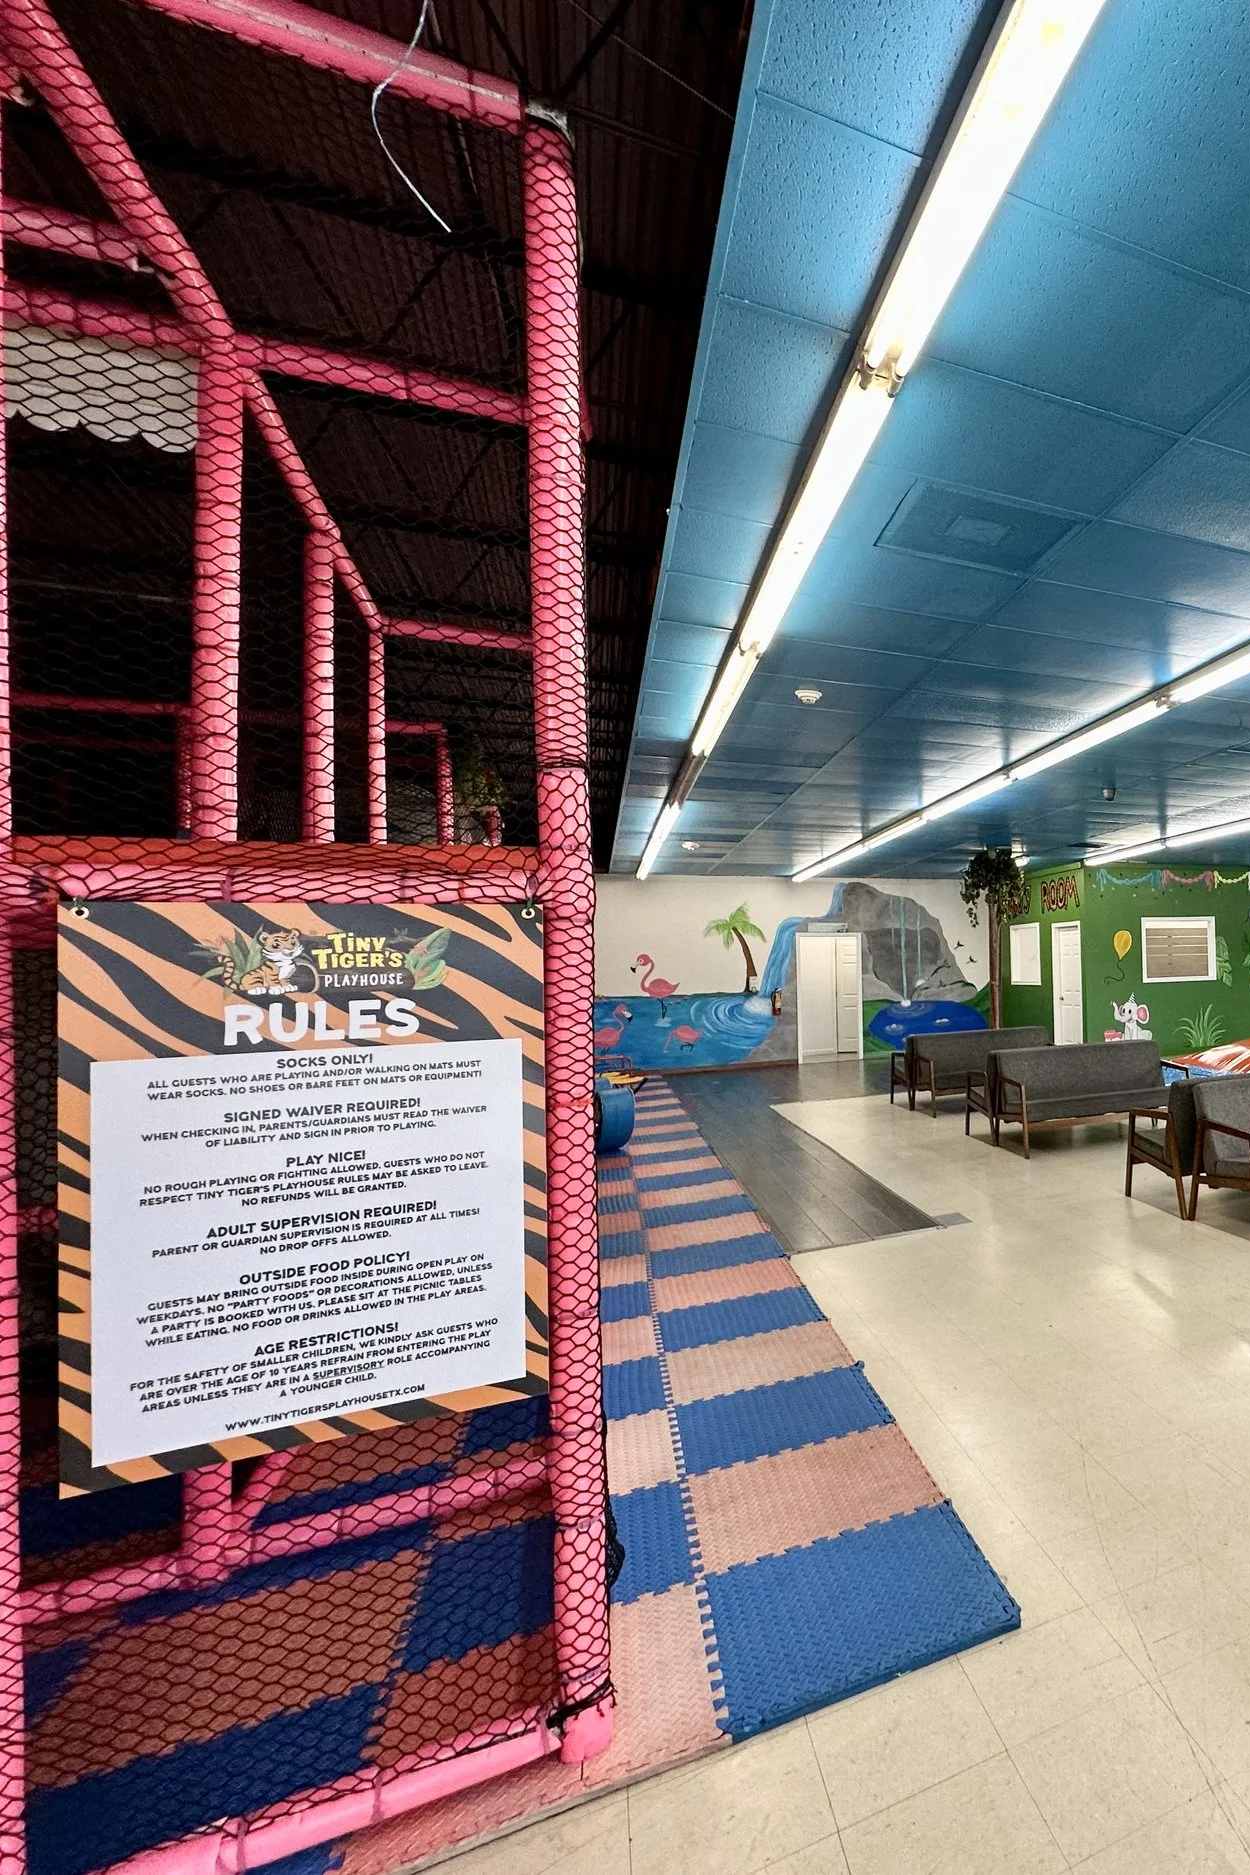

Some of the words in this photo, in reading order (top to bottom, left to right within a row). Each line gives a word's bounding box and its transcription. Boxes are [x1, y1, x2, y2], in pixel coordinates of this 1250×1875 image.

[1041, 876, 1080, 914] ROOM
[324, 972, 404, 988] PLAYHOUSE
[223, 997, 420, 1046] RULES
[147, 1080, 169, 1089] ALL
[171, 1076, 216, 1087] GUESTS
[219, 1075, 248, 1084] WHO
[250, 1073, 272, 1082] ARE
[274, 1070, 320, 1080] PLAYING
[364, 1064, 410, 1074] WALKING
[412, 1063, 427, 1071] ON
[428, 1061, 454, 1070] MATS
[455, 1059, 481, 1068] MUST
[276, 1056, 327, 1069] SOCKS
[330, 1053, 373, 1065] ONLY!
[146, 1090, 183, 1101] WEAR
[185, 1088, 227, 1098] SOCKS.
[229, 1086, 246, 1095] NO
[249, 1083, 285, 1093] SHOES
[288, 1082, 303, 1091] OR
[305, 1080, 333, 1089] BARE
[335, 1078, 361, 1087] FEET
[363, 1077, 378, 1085] ON
[380, 1075, 406, 1084] MATS
[408, 1074, 422, 1082] OR
[424, 1070, 482, 1081] EQUIPMENT!
[140, 1131, 178, 1142] WHEN
[180, 1126, 239, 1138] CHECKING
[373, 1112, 401, 1122] MUST
[402, 1109, 428, 1119] READ
[430, 1108, 449, 1116] THE
[451, 1105, 487, 1114] WAIVER
[223, 1108, 281, 1123] SIGNED
[285, 1103, 343, 1118] WAIVER
[346, 1097, 420, 1113] REQUIRED!
[204, 1139, 221, 1148] OF
[223, 1134, 276, 1146] LIABILITY
[278, 1131, 301, 1141] AND
[303, 1129, 329, 1139] SIGN
[330, 1128, 341, 1136] IN
[343, 1125, 375, 1135] PRIOR
[376, 1123, 391, 1132] TO
[392, 1120, 437, 1131] PLAYING.
[143, 1185, 162, 1195] NO
[165, 1180, 206, 1192] ROUGH
[208, 1175, 257, 1187] PLAYING
[259, 1172, 275, 1182] OR
[277, 1167, 328, 1180] FIGHTING
[330, 1161, 381, 1174] ALLOWED.
[383, 1157, 421, 1168] GUESTS
[423, 1154, 448, 1164] WHO
[449, 1153, 463, 1161] DO
[465, 1150, 485, 1160] NOT
[285, 1154, 324, 1168] PLAY
[328, 1149, 366, 1163] NICE!
[139, 1193, 193, 1207] RESPECT
[196, 1189, 224, 1200] TINY
[272, 1177, 335, 1192] PLAYHOUSE
[337, 1173, 370, 1184] RULES
[372, 1171, 393, 1180] MAY
[395, 1169, 408, 1178] BE
[410, 1166, 441, 1176] ASKED
[443, 1164, 457, 1172] TO
[458, 1161, 488, 1171] LEAVE.
[241, 1197, 258, 1207] NO
[260, 1191, 311, 1204] REFUNDS
[313, 1188, 340, 1198] WILL
[341, 1186, 355, 1195] BE
[357, 1180, 406, 1193] GRANTED.
[152, 1244, 199, 1258] PARENT
[201, 1241, 218, 1251] OR
[220, 1233, 278, 1248] GUARDIAN
[279, 1224, 350, 1240] SUPERVISION
[351, 1222, 361, 1231] IS
[363, 1216, 413, 1230] REQUIRED
[415, 1214, 428, 1223] AT
[429, 1212, 447, 1221] ALL
[448, 1207, 480, 1218] TIMES!
[206, 1222, 257, 1239] ADULT
[260, 1209, 360, 1232] SUPERVISION
[363, 1200, 437, 1219] REQUIRED!
[259, 1245, 277, 1255] NO
[278, 1241, 309, 1252] DROP
[310, 1237, 338, 1247] OFFS
[340, 1230, 391, 1243] ALLOWED.
[147, 1297, 194, 1311] GUESTS
[196, 1292, 221, 1304] MAY
[223, 1286, 259, 1299] BRING
[260, 1279, 308, 1293] OUTSIDE
[309, 1275, 338, 1286] FOOD
[340, 1269, 374, 1282] INSIDE
[376, 1263, 414, 1276] DURING
[415, 1259, 442, 1270] OPEN
[444, 1255, 468, 1266] PLAY
[470, 1253, 484, 1262] ON
[239, 1265, 306, 1285] OUTSIDE
[309, 1259, 350, 1275] FOOD
[353, 1250, 410, 1269] POLICY!
[135, 1307, 205, 1325] WEEKDAYS.
[207, 1303, 225, 1313] NO
[316, 1287, 332, 1296] OR
[333, 1275, 404, 1293] DECORATIONS
[457, 1262, 493, 1274] UNLESS
[150, 1326, 159, 1335] A
[161, 1319, 201, 1333] PARTY
[204, 1316, 215, 1326] IS
[217, 1309, 264, 1324] BOOKED
[266, 1303, 296, 1315] WITH
[298, 1301, 316, 1310] US.
[317, 1294, 356, 1307] PLEASE
[358, 1291, 375, 1300] SIT
[377, 1288, 389, 1297] AT
[391, 1285, 411, 1295] THE
[413, 1280, 446, 1292] PICNIC
[447, 1274, 482, 1286] TABLES
[254, 1341, 285, 1357] AGE
[288, 1321, 399, 1351] RESTRICTIONS!
[279, 1389, 287, 1397] A
[290, 1378, 342, 1395] YOUNGER
[344, 1372, 376, 1384] CHILD.
